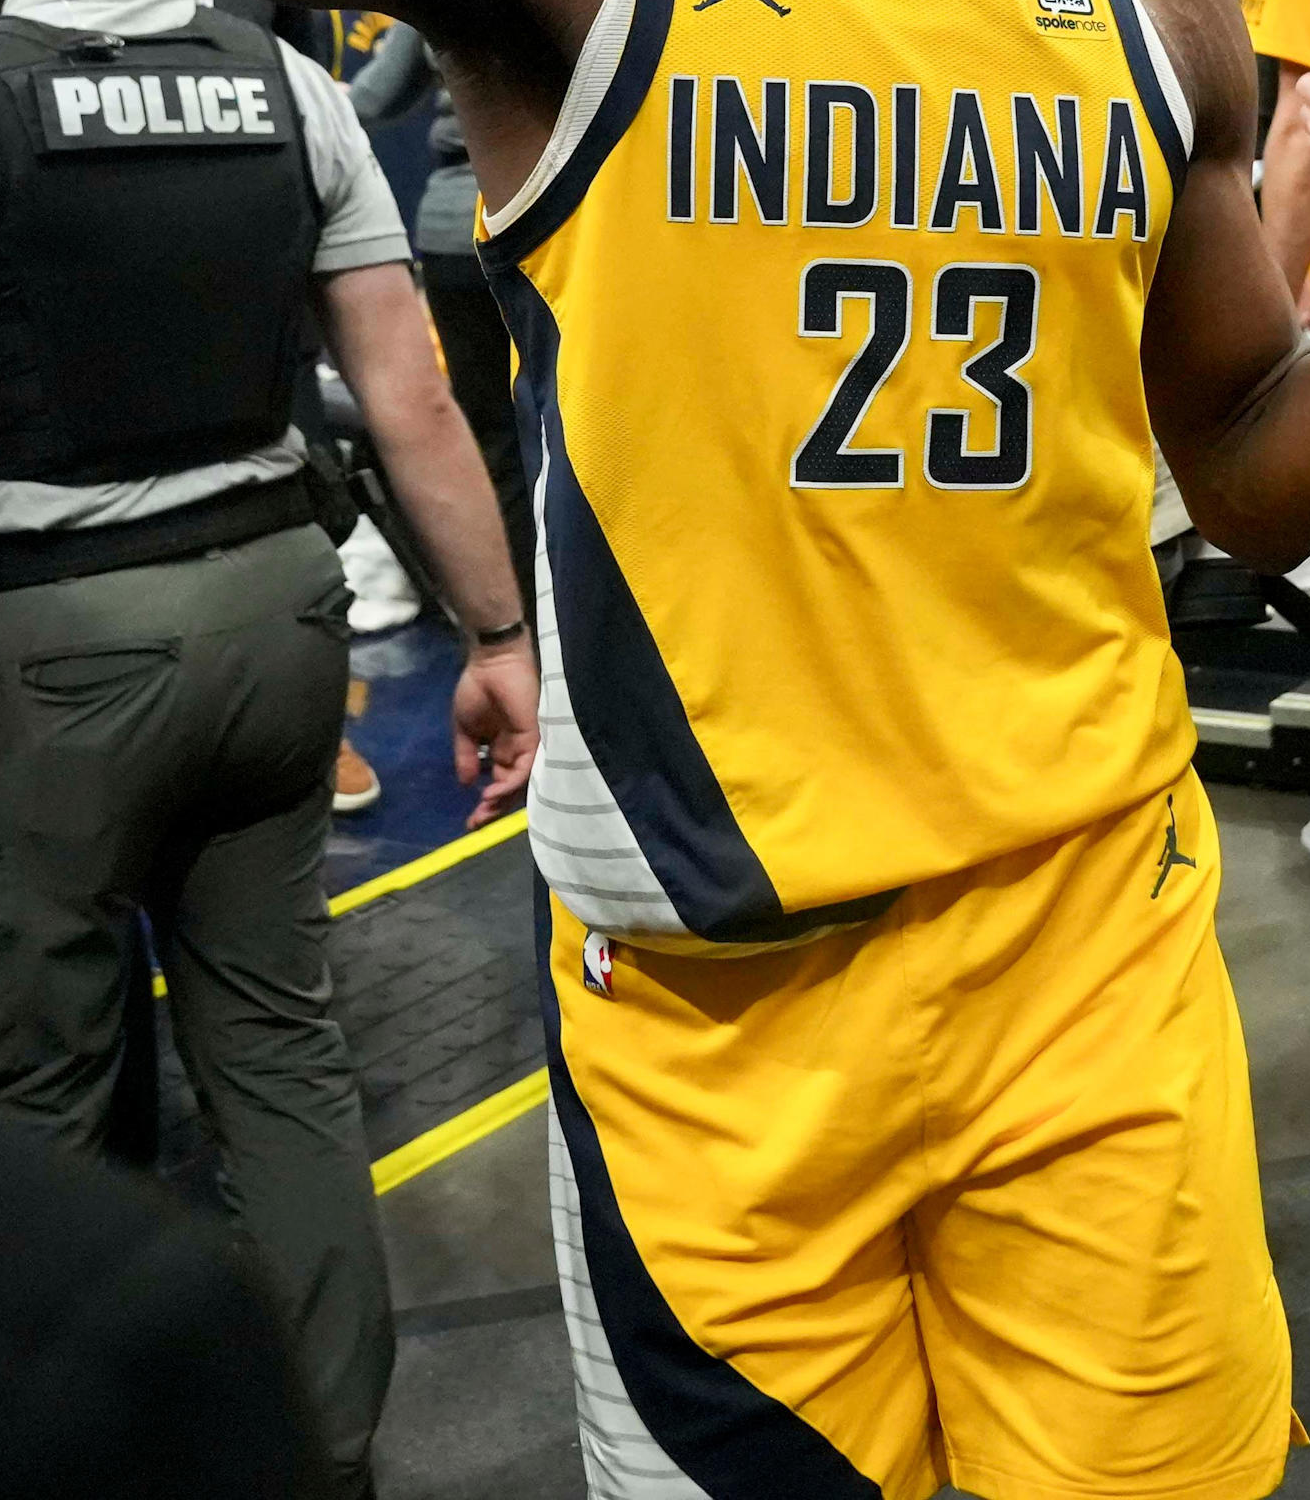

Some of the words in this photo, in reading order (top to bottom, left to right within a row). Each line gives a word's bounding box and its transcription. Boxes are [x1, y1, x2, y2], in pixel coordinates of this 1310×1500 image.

[1035, 14, 1107, 32] spokenote
[52, 76, 276, 137] POLICE
[667, 74, 1150, 243] INDIANA
[790, 258, 1042, 491] 23
